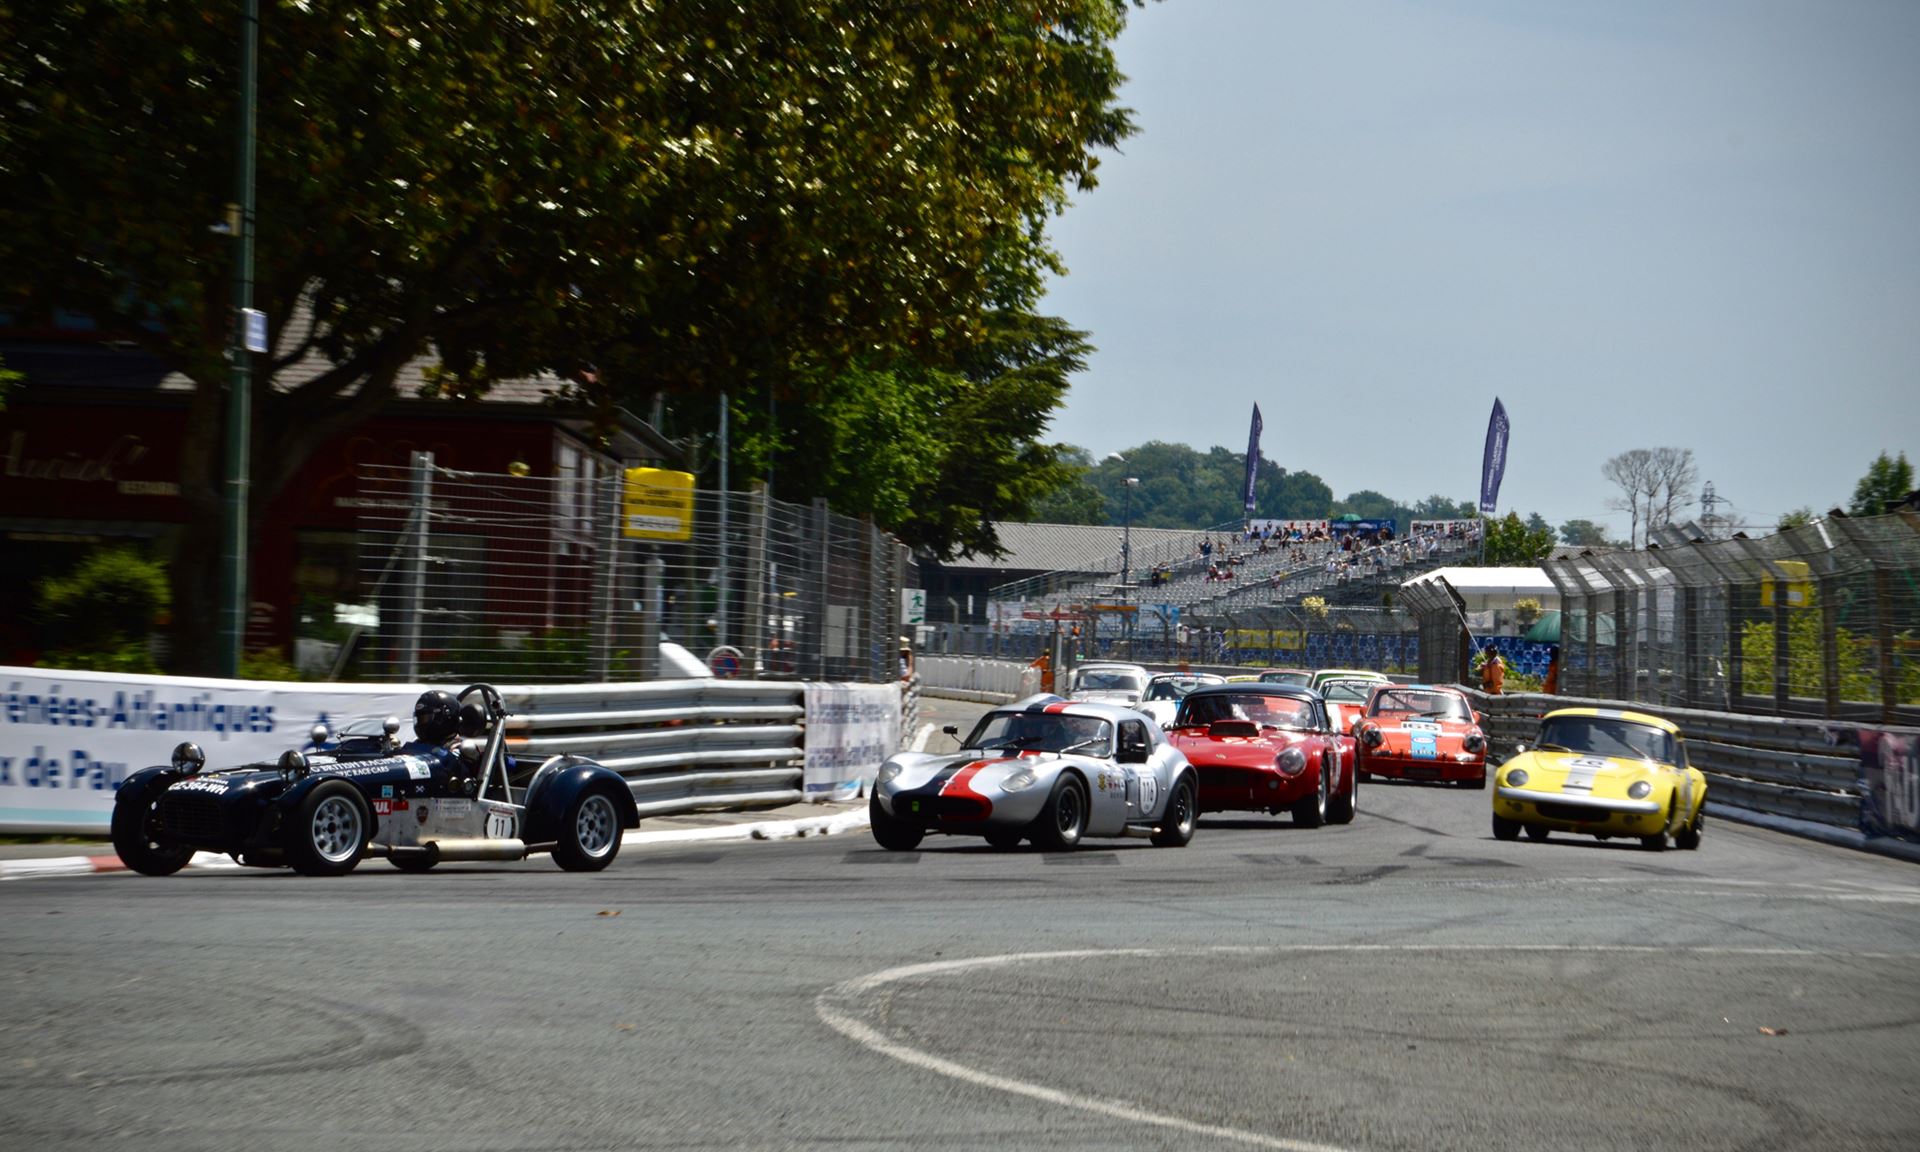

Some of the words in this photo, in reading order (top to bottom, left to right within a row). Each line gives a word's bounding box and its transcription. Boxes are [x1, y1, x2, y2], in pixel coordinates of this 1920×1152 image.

[0, 681, 276, 741] énées-Atlantiques
[25, 746, 62, 788] de
[69, 750, 127, 791] Pau
[320, 761, 360, 772] BRITISH
